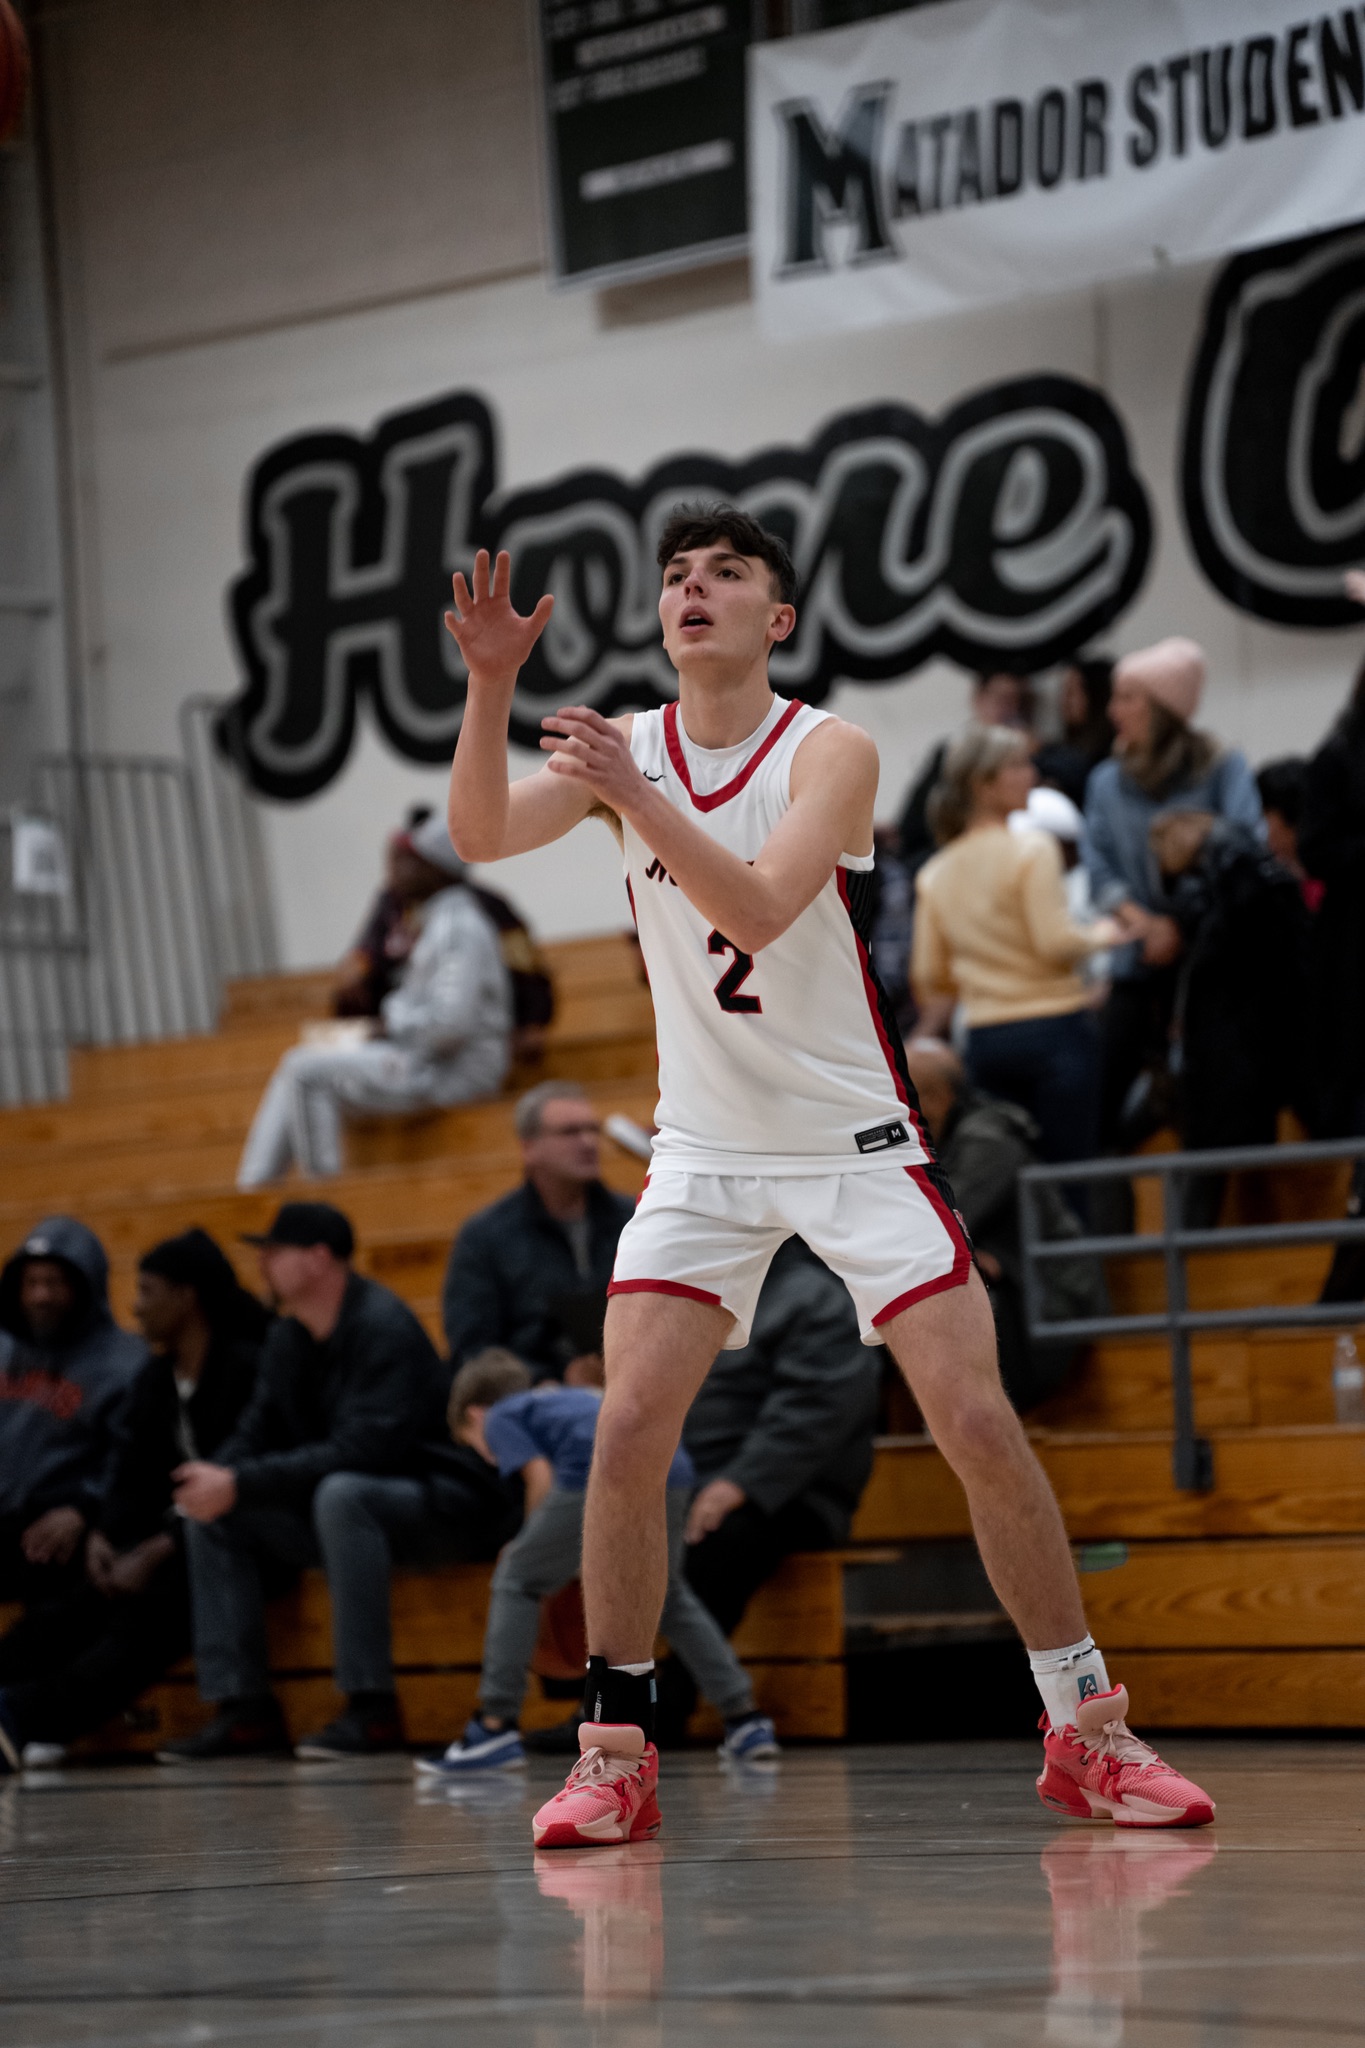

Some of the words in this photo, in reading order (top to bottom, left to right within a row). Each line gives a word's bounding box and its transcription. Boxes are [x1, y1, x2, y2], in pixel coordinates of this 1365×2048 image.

[774, 79, 1108, 276] MATADOR
[1127, 7, 1365, 167] STUDEN
[228, 391, 1150, 797] Home
[707, 928, 762, 1014] 2
